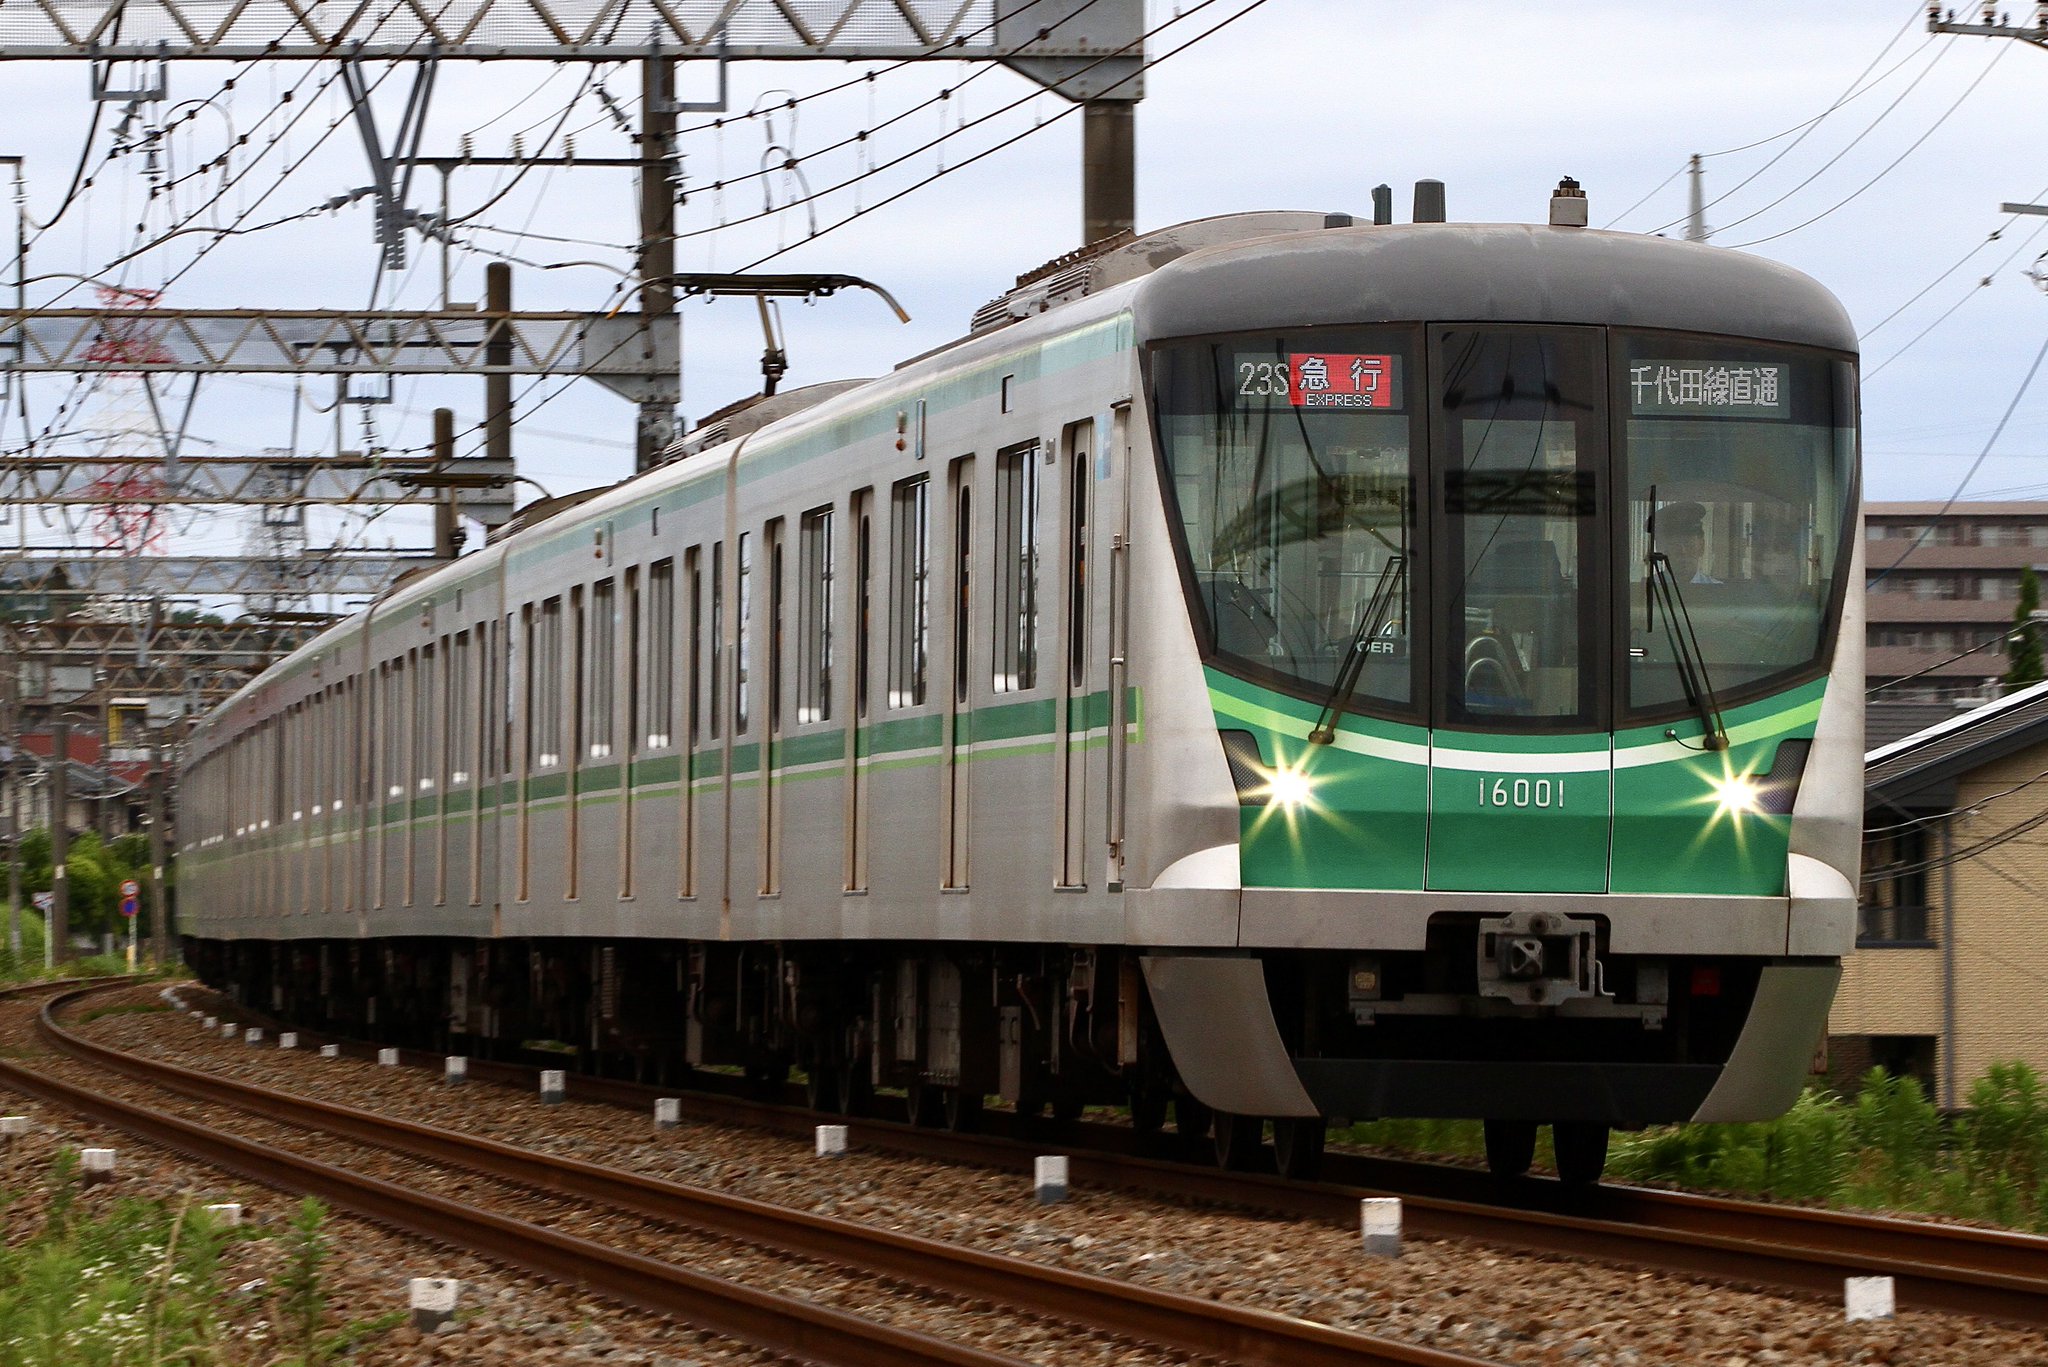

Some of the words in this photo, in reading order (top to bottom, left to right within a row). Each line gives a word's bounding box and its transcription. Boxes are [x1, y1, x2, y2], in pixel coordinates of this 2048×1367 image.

[1239, 362, 1290, 396] 23S
[1630, 366, 1779, 406] 千代田線直通
[1306, 393, 1372, 407] EXPRESS
[1479, 777, 1564, 808] 16001
